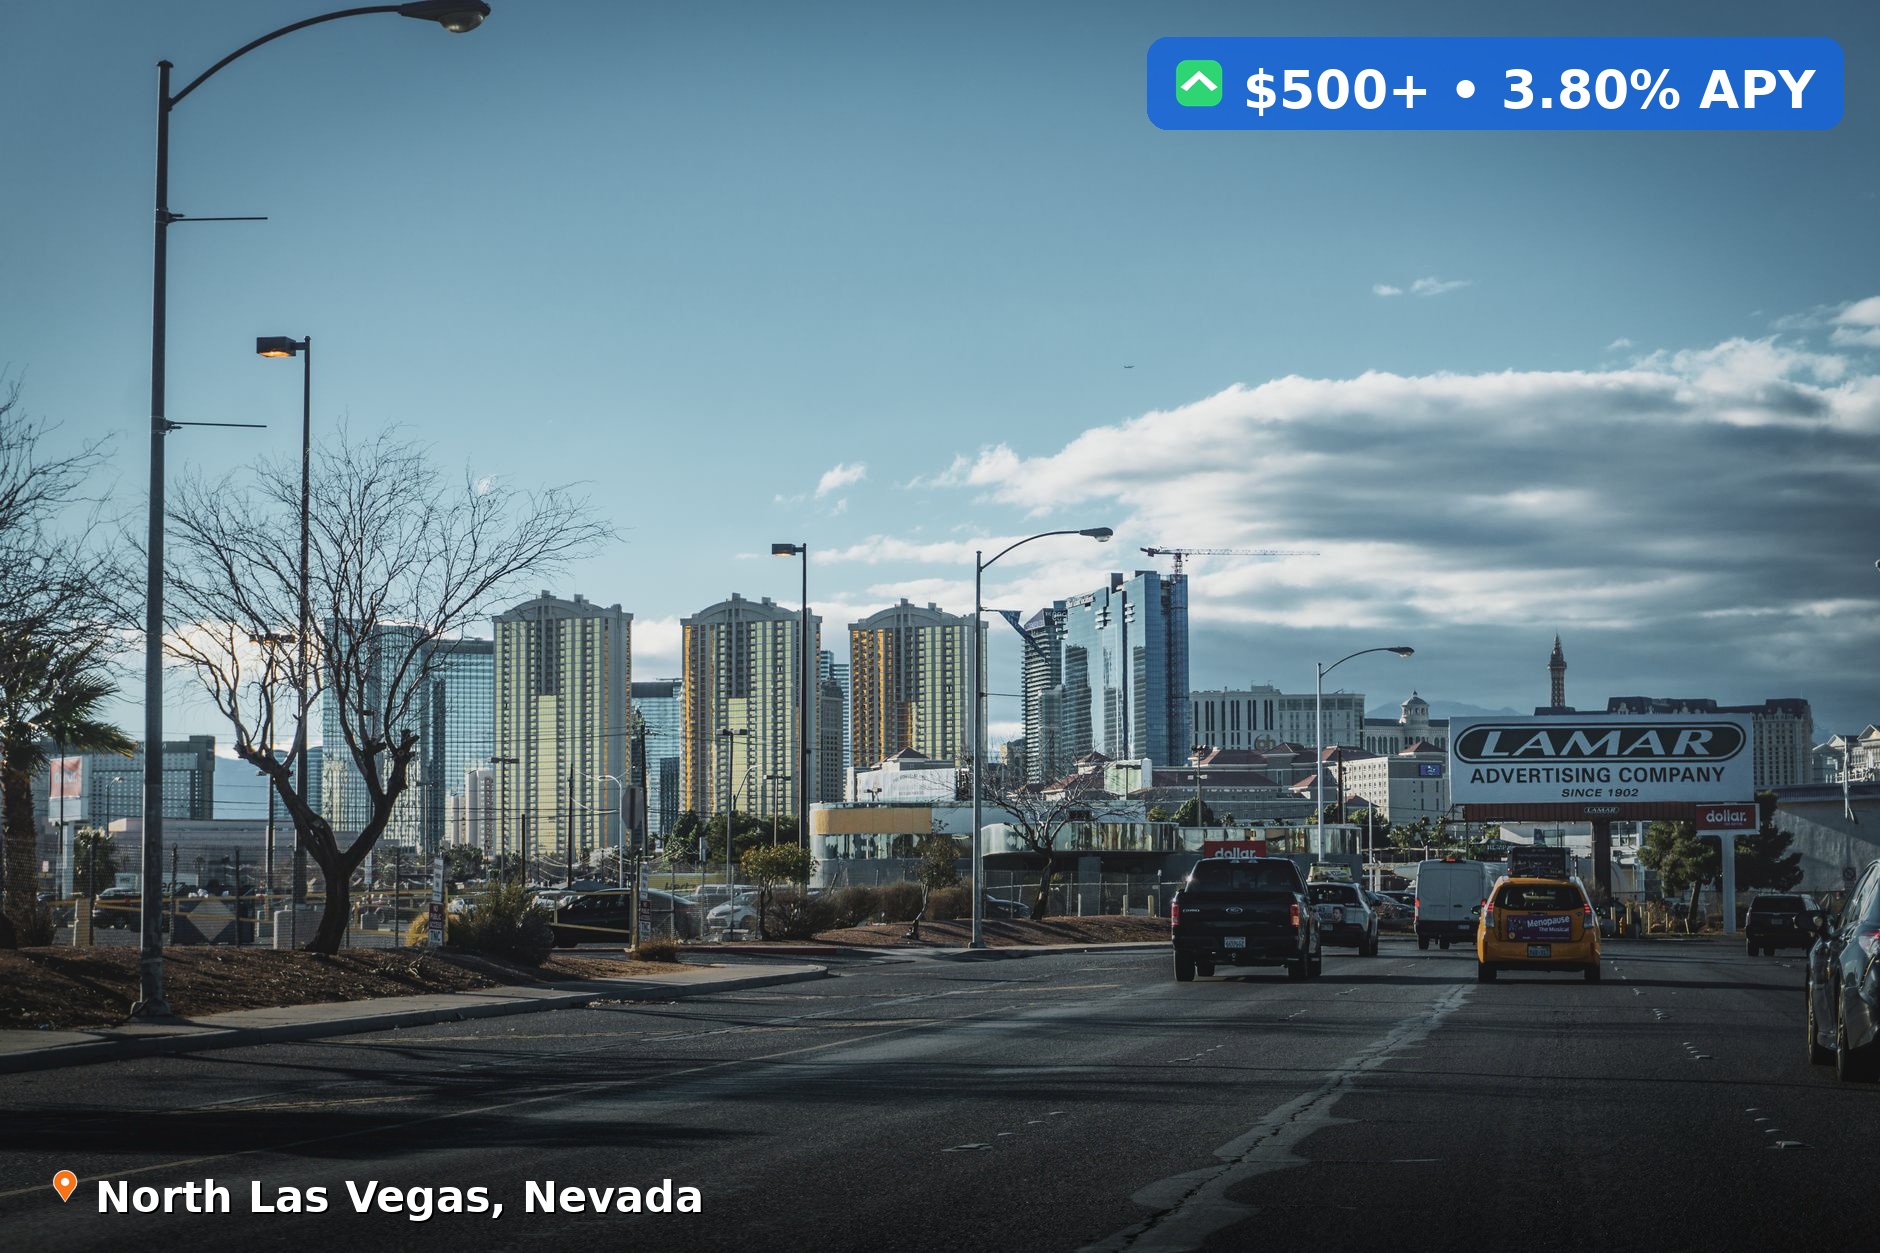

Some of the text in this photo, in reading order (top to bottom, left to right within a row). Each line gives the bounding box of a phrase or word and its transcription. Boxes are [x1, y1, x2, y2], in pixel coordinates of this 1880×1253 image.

[1480, 729, 1713, 757] LAMAR
[1470, 766, 1725, 784] ADVERTISING COMPANY
[1561, 788, 1639, 798] SINCE 1902
[1705, 809, 1747, 823] dollar.
[1526, 915, 1570, 928] Menopause
